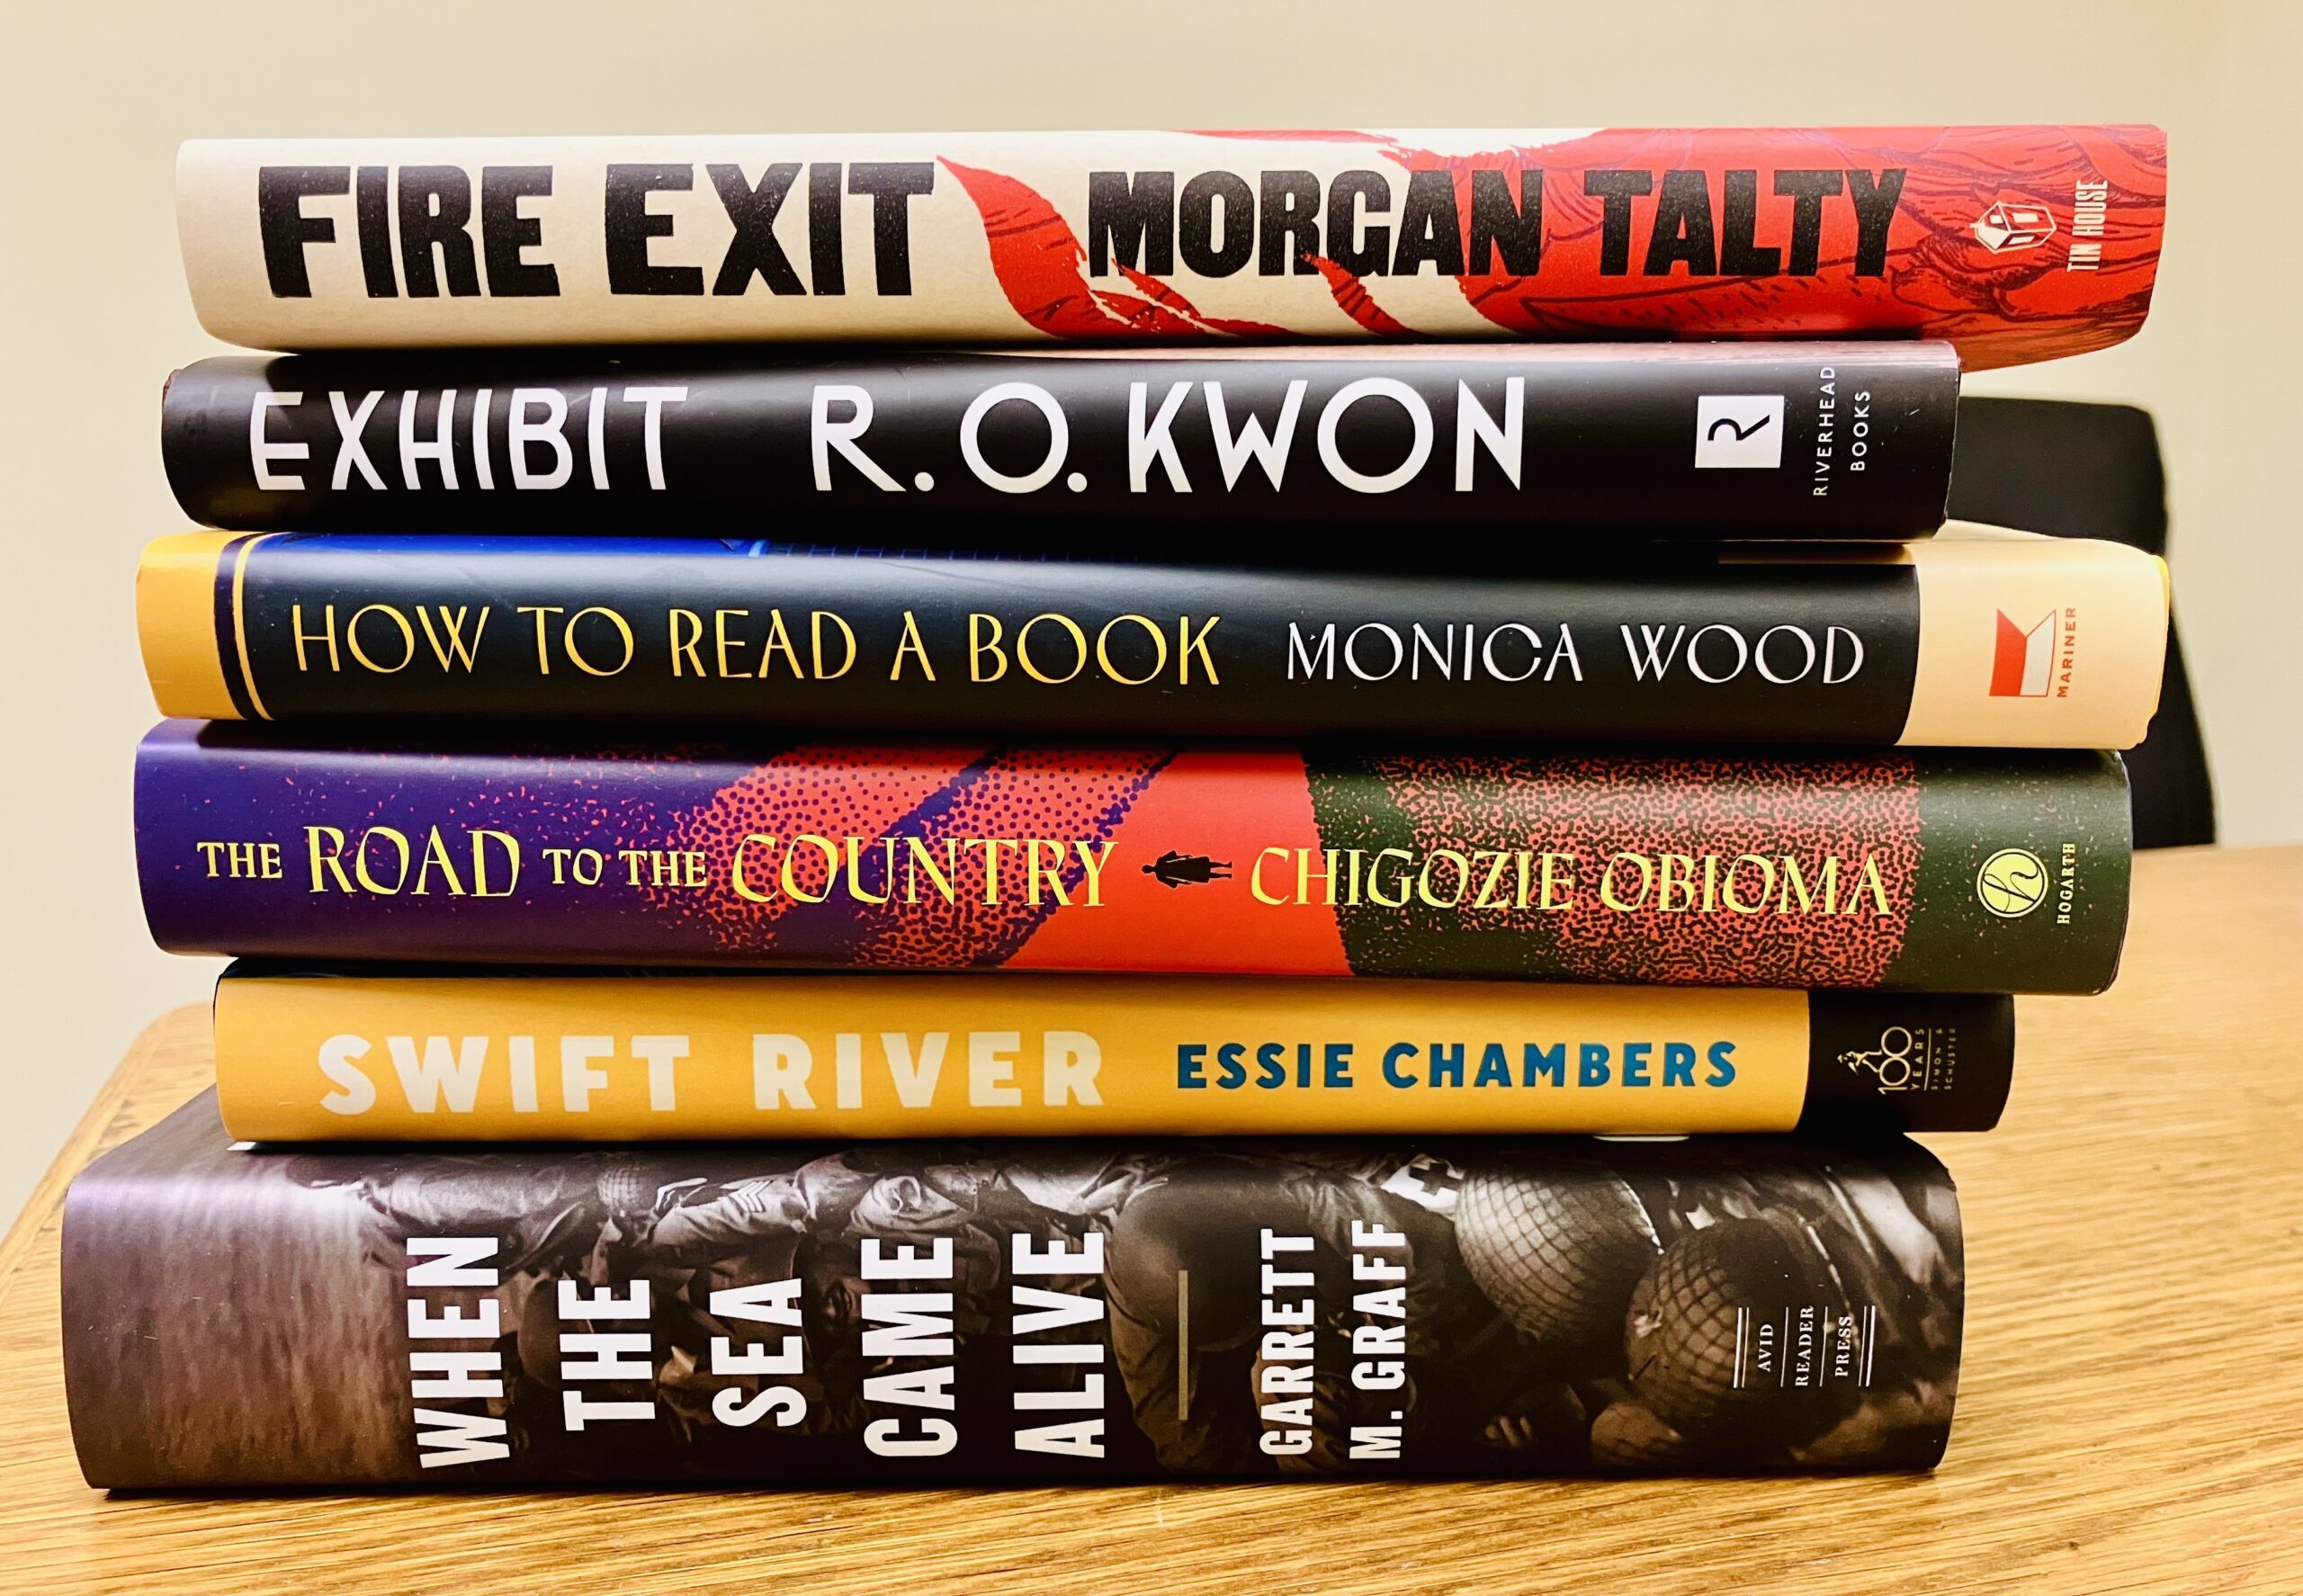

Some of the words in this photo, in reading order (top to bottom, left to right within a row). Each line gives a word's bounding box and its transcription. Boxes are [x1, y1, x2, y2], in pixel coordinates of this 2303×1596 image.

[258, 165, 561, 298] FIRE
[605, 162, 935, 296] EXIT
[1087, 169, 1548, 278] MORGAN
[1584, 168, 1908, 278] TALTY
[2072, 180, 2108, 236] HOUSE
[2066, 244, 2101, 272] TIN
[249, 386, 689, 491] EXHIBIT
[811, 384, 935, 492] R.
[959, 382, 1089, 493] O.
[1128, 377, 1526, 493] KWON
[1813, 366, 1835, 496] RIVERHEAD
[1850, 391, 1870, 471] BOOKS
[291, 604, 490, 675] HOW
[517, 605, 634, 677] TO
[669, 608, 857, 679] READ
[890, 610, 936, 682] A
[969, 613, 1220, 686] BOOK
[1287, 622, 1583, 682] MONICA
[1620, 623, 1865, 684] WOOD
[2057, 607, 2076, 697] MARINER
[197, 841, 281, 879] THE
[302, 825, 520, 898] ROAD
[542, 847, 603, 886] TO
[619, 850, 708, 888] THE
[730, 834, 1119, 908] COUNTRY
[1250, 846, 1575, 910] CHIGOZIE
[1600, 851, 1891, 917] OBIOMA
[2057, 843, 2076, 925] HOGARTH
[318, 1034, 691, 1115] SWIFT
[752, 1031, 1104, 1110] RIVER
[1178, 1043, 1354, 1089] ESSIE
[1382, 1042, 1736, 1088] CHAMBERS
[1911, 1028, 1925, 1089] YEARS
[1931, 1047, 1942, 1090] SIMON
[1012, 1232, 1105, 1458] ALIVE
[1259, 1228, 1314, 1456] GARRETT
[1350, 1220, 1406, 1390] GRAFF
[1795, 1305, 1815, 1386] READER
[1834, 1316, 1853, 1377] PRESS
[407, 1237, 510, 1468] WHEN
[558, 1279, 656, 1431] THE
[709, 1278, 807, 1428] SEA
[860, 1238, 958, 1457] CAME
[1757, 1323, 1774, 1372] AVID
[1349, 1410, 1402, 1459] M.
